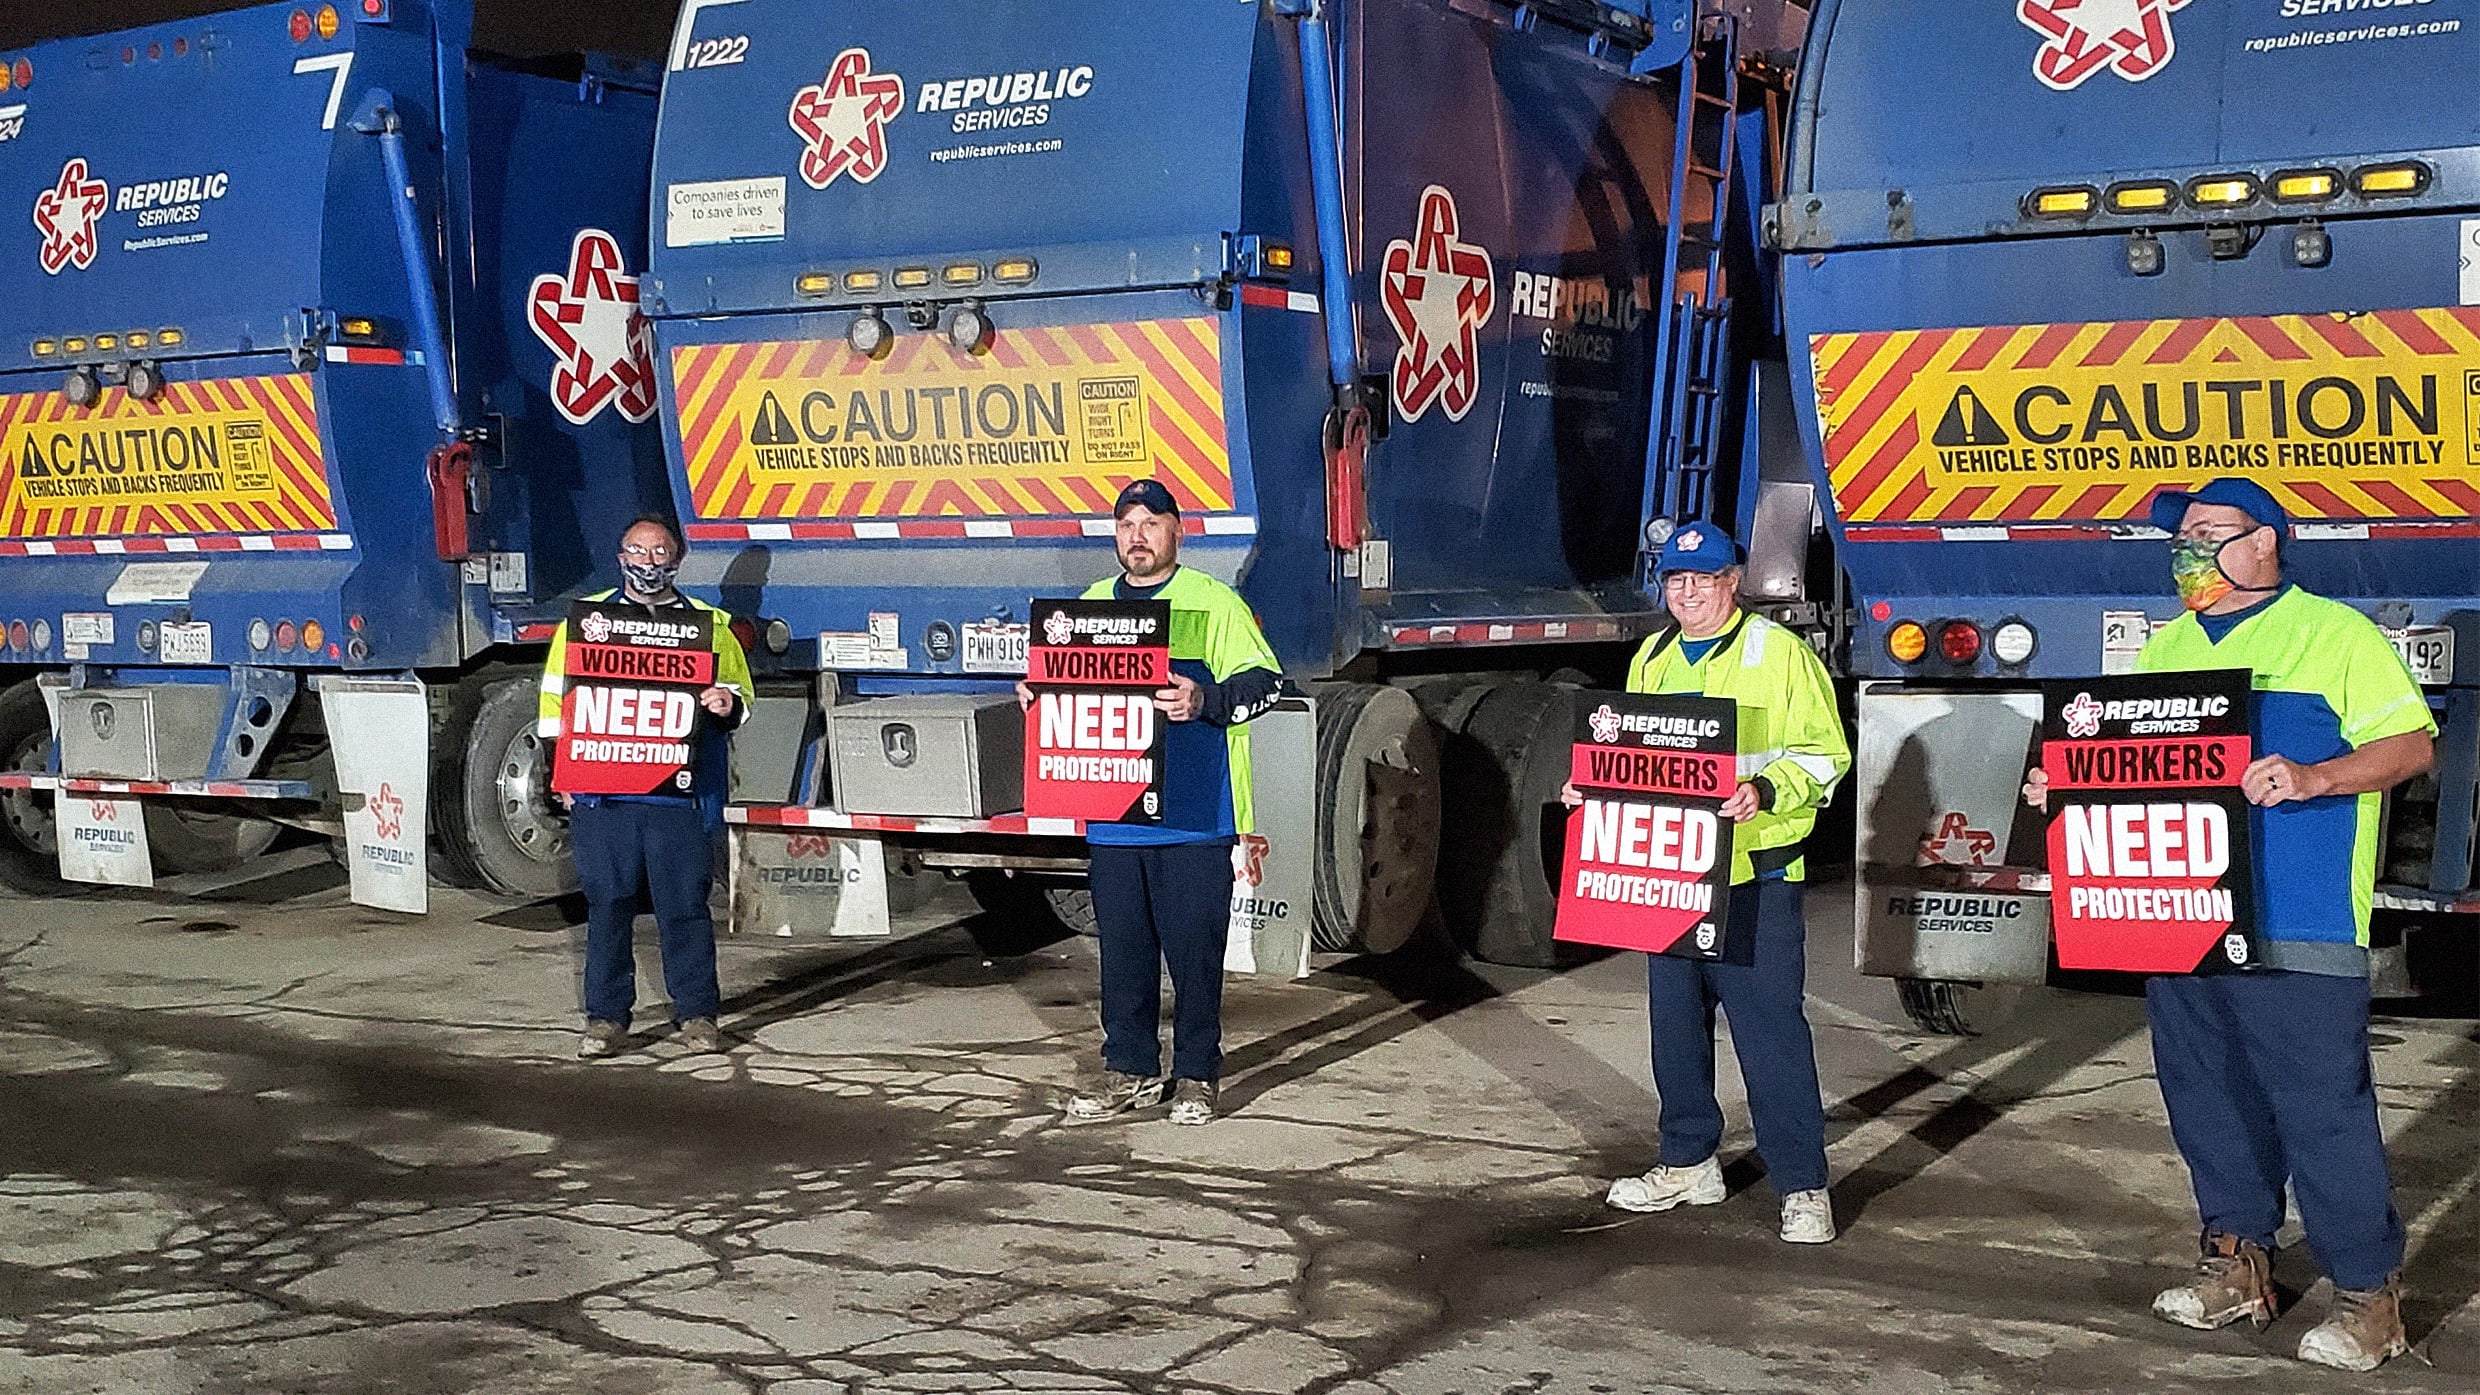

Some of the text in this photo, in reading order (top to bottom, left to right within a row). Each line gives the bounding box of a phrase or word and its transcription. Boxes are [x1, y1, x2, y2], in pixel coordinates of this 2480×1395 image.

[2244, 20, 2461, 52] republicservices.com
[688, 36, 749, 68] 1222
[917, 66, 1094, 113] REPUBLIC
[0, 117, 25, 140] 24
[952, 105, 1050, 133] SERVICES
[930, 139, 1063, 162] republicservices.com
[116, 173, 228, 211] REPUBLIC
[674, 185, 779, 205] Companies driven
[138, 204, 200, 227] SERVICES
[693, 203, 763, 219] to save lives
[1512, 271, 1641, 332] REPUBLIC
[1083, 382, 1136, 397] CAUTION
[800, 382, 1065, 444] CAUTION
[2013, 375, 2438, 446] CAUTION
[50, 425, 220, 476] CAUTION
[755, 439, 1070, 470] VEHICLE STOPS AND BACKS FREQUENTLY
[1938, 440, 2445, 473] VEHICLE STOPS AND BACKS FREQUENTLY
[24, 479, 65, 498] VEHICLE
[67, 478, 99, 497] STOPS
[101, 477, 121, 495] AND
[123, 475, 158, 494] BACKS
[159, 472, 226, 492] FREQUENTLY
[612, 620, 700, 640] REPUBLIC
[1074, 618, 1157, 634] REPUBLIC
[630, 635, 680, 647] SERVICES
[1092, 634, 1138, 645] SERVICES
[580, 648, 696, 679] WORKERS
[1044, 651, 1154, 680] WORKERS
[573, 685, 696, 739] NEED
[2104, 695, 2230, 721] REPUBLIC
[1039, 694, 1155, 750] NEED
[1622, 714, 1721, 738] REPUBLIC
[2130, 719, 2200, 735] SERVICES
[570, 739, 690, 765] PROTECTION
[1642, 733, 1698, 749] SERVICES
[1039, 755, 1153, 784] PROTECTION
[1589, 751, 1718, 792] WORKERS
[2065, 743, 2226, 783] WORKERS
[74, 827, 135, 844] REPUBLIC
[1580, 799, 1718, 874] NEED
[2063, 803, 2231, 878] NEED
[362, 845, 415, 866] REPUBLIC
[757, 867, 861, 883] REPUBLIC
[1575, 869, 1713, 913] PROTECTION
[1231, 897, 1289, 919] UBLIC
[1888, 897, 2021, 919] REPUBLIC
[2071, 886, 2234, 924] PROTECTION
[1231, 916, 1266, 930] VICES
[1917, 919, 1994, 933] SERVICES
